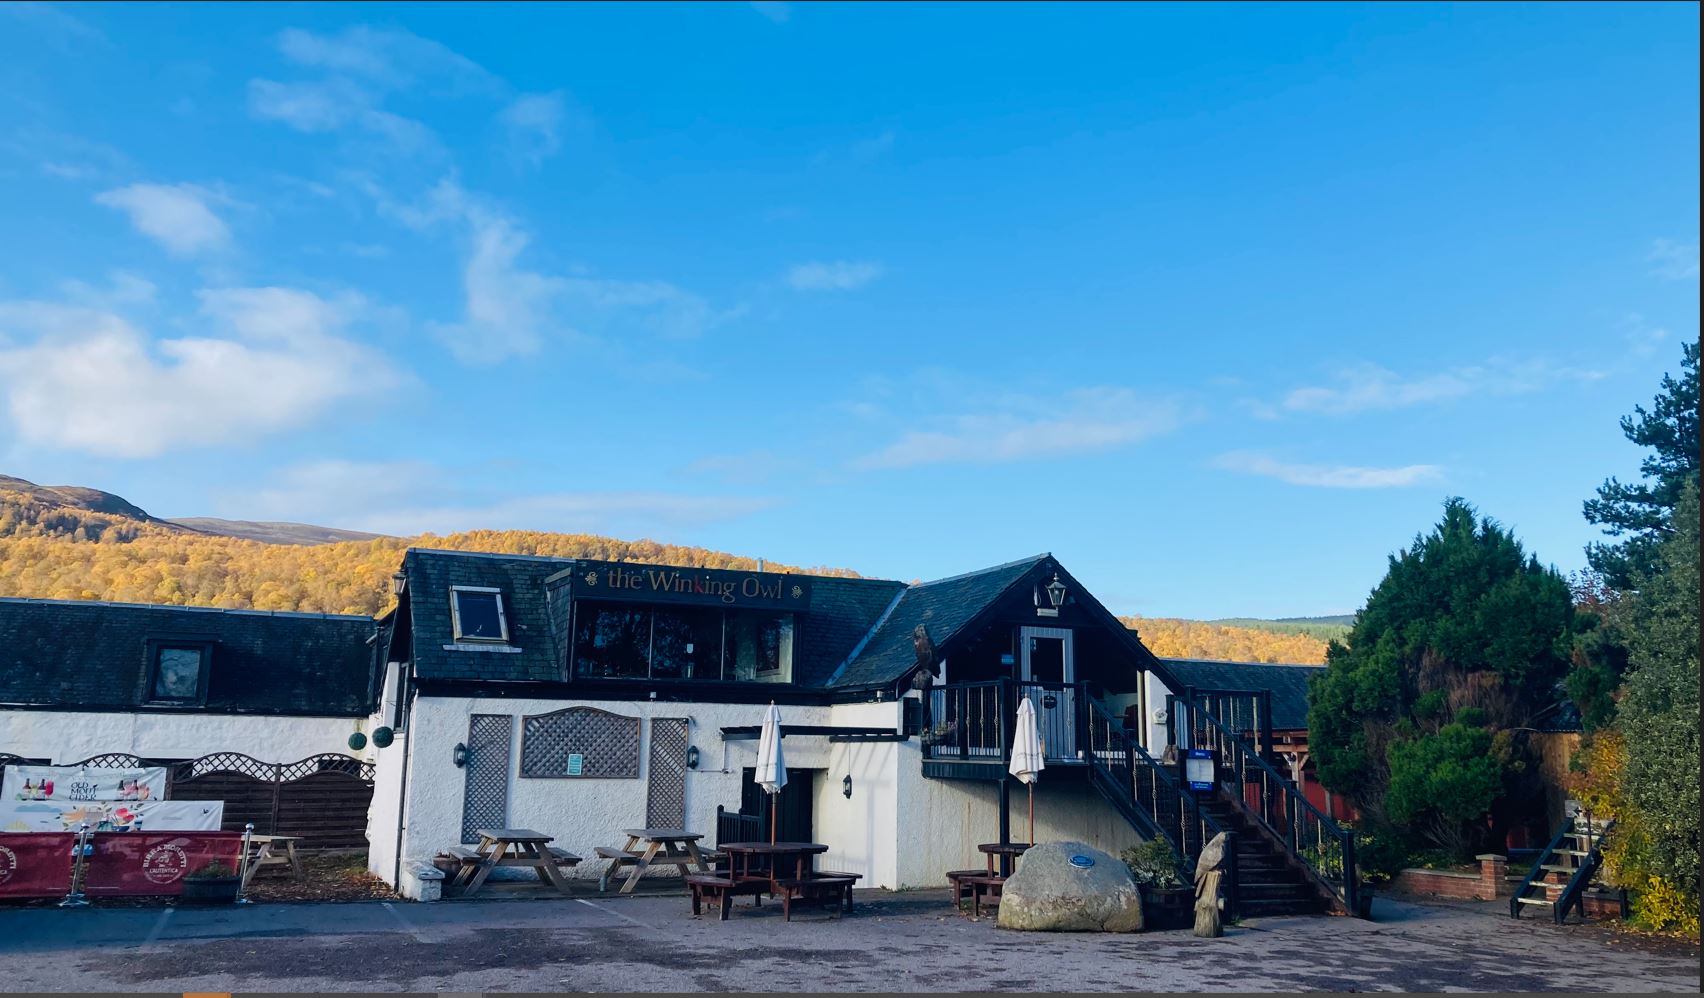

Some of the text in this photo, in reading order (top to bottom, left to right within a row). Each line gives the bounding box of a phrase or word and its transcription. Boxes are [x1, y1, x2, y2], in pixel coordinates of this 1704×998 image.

[608, 567, 783, 604] the Winking Owl
[70, 781, 89, 789] OLD
[163, 844, 187, 867] MORETTI
